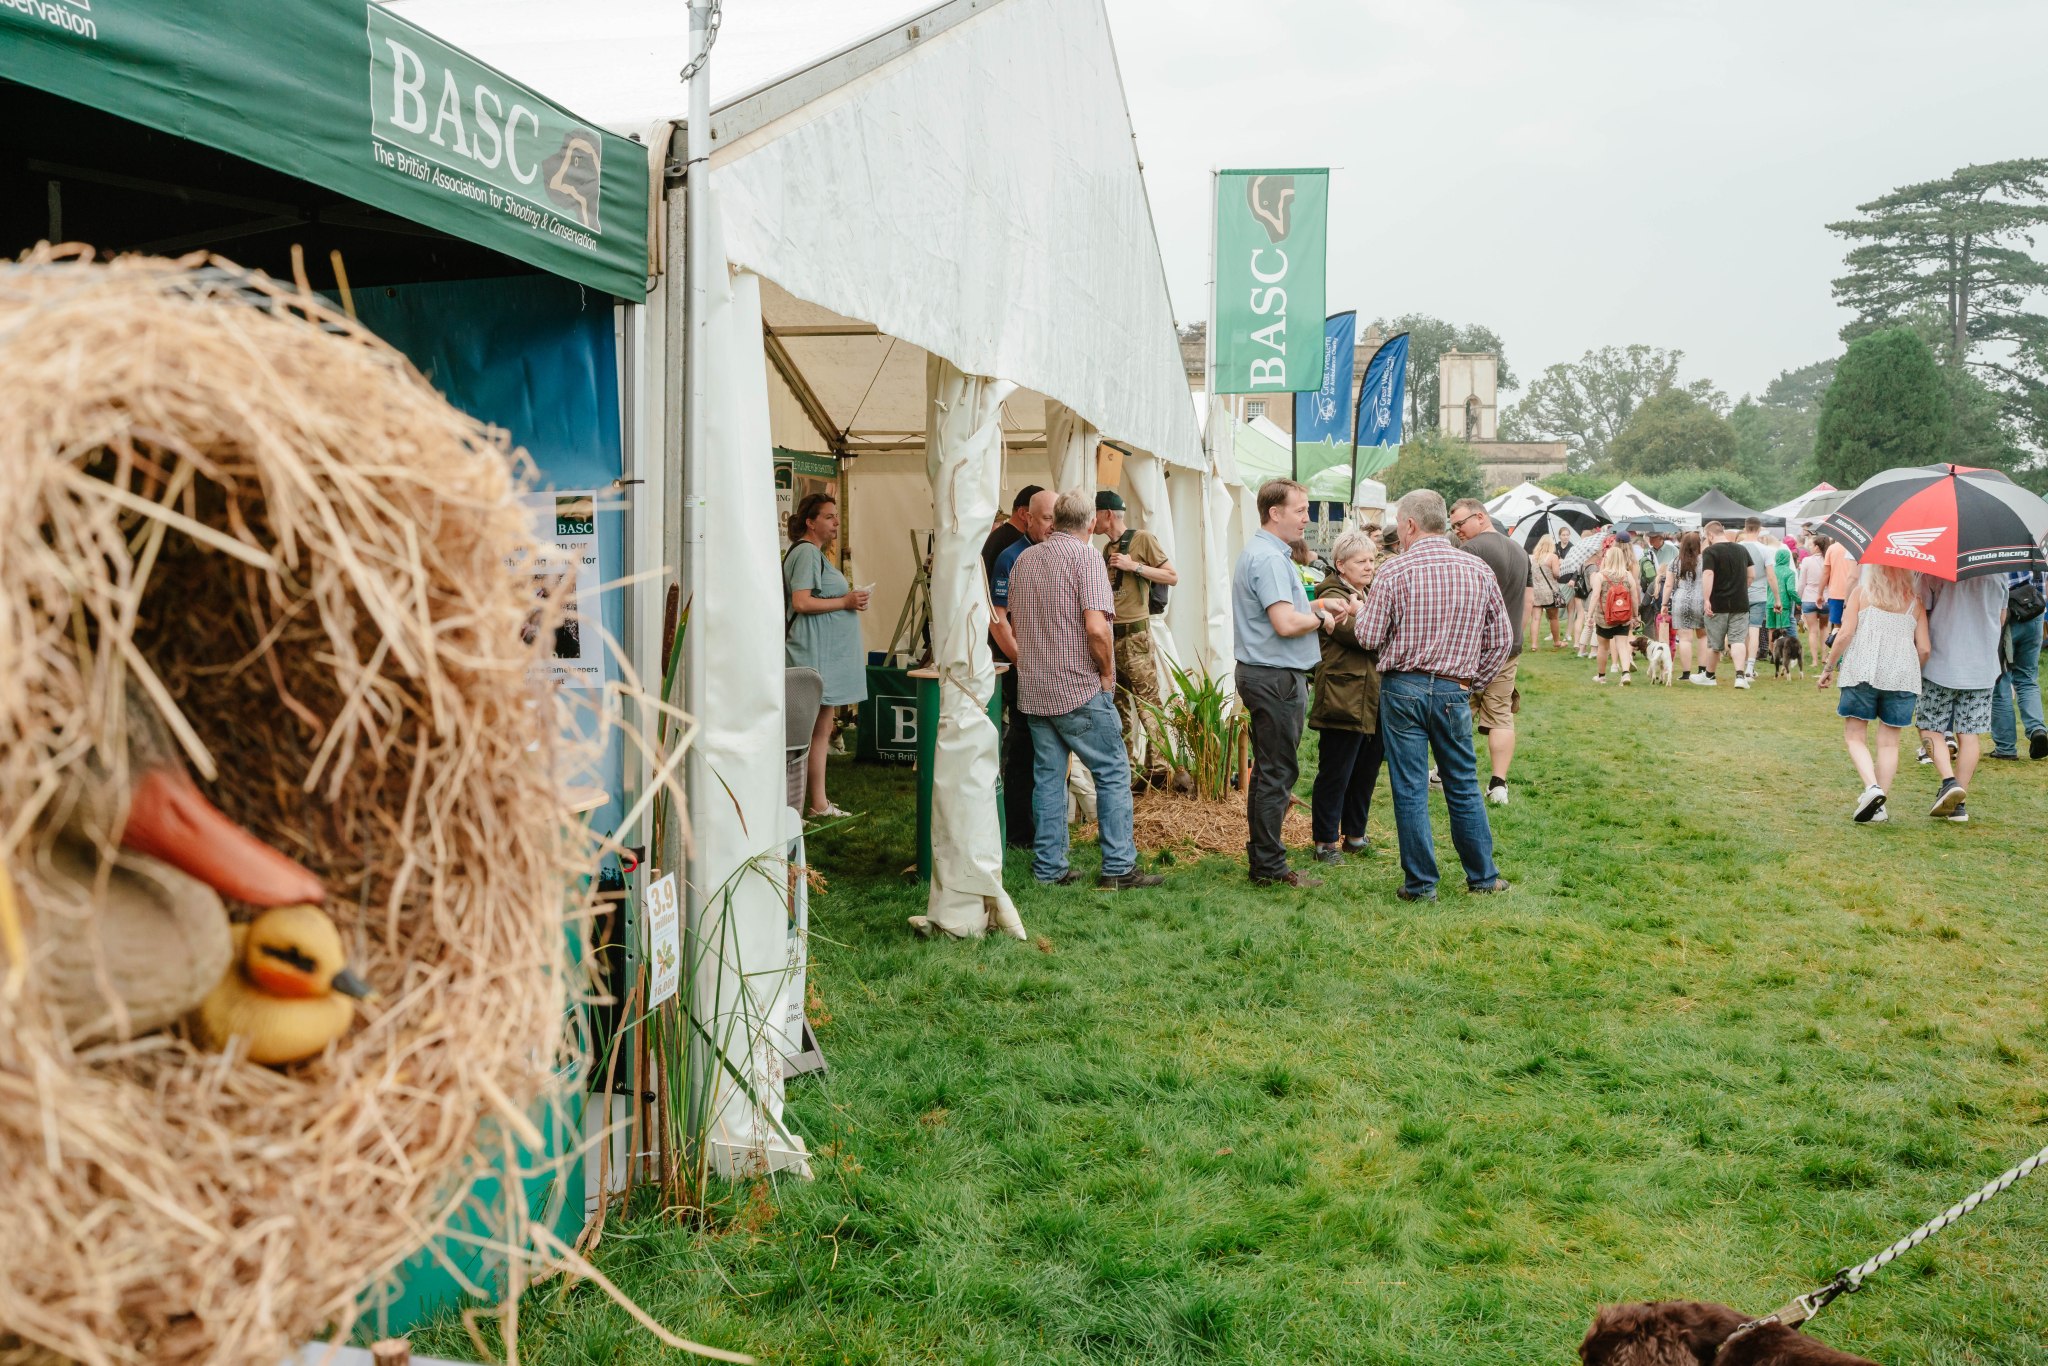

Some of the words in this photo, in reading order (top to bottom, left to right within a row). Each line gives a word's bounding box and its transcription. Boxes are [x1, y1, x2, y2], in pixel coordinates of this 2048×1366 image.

[385, 37, 540, 185] BASC
[372, 141, 395, 168] The
[397, 152, 430, 183] British
[432, 167, 488, 204] Association
[489, 187, 503, 207] for
[504, 195, 541, 229] Shooting
[540, 213, 548, 230] &
[549, 217, 597, 252] Conservation
[1250, 247, 1289, 389] BASC
[1320, 372, 1330, 396] Great
[557, 522, 594, 535] BASC
[1850, 527, 1867, 544] Racing
[1884, 546, 1937, 563] HONDA
[1967, 552, 1997, 563] Honda
[1998, 549, 2030, 560] Racing
[878, 751, 895, 761] The
[651, 880, 675, 917] 3.9
[654, 911, 675, 932] million
